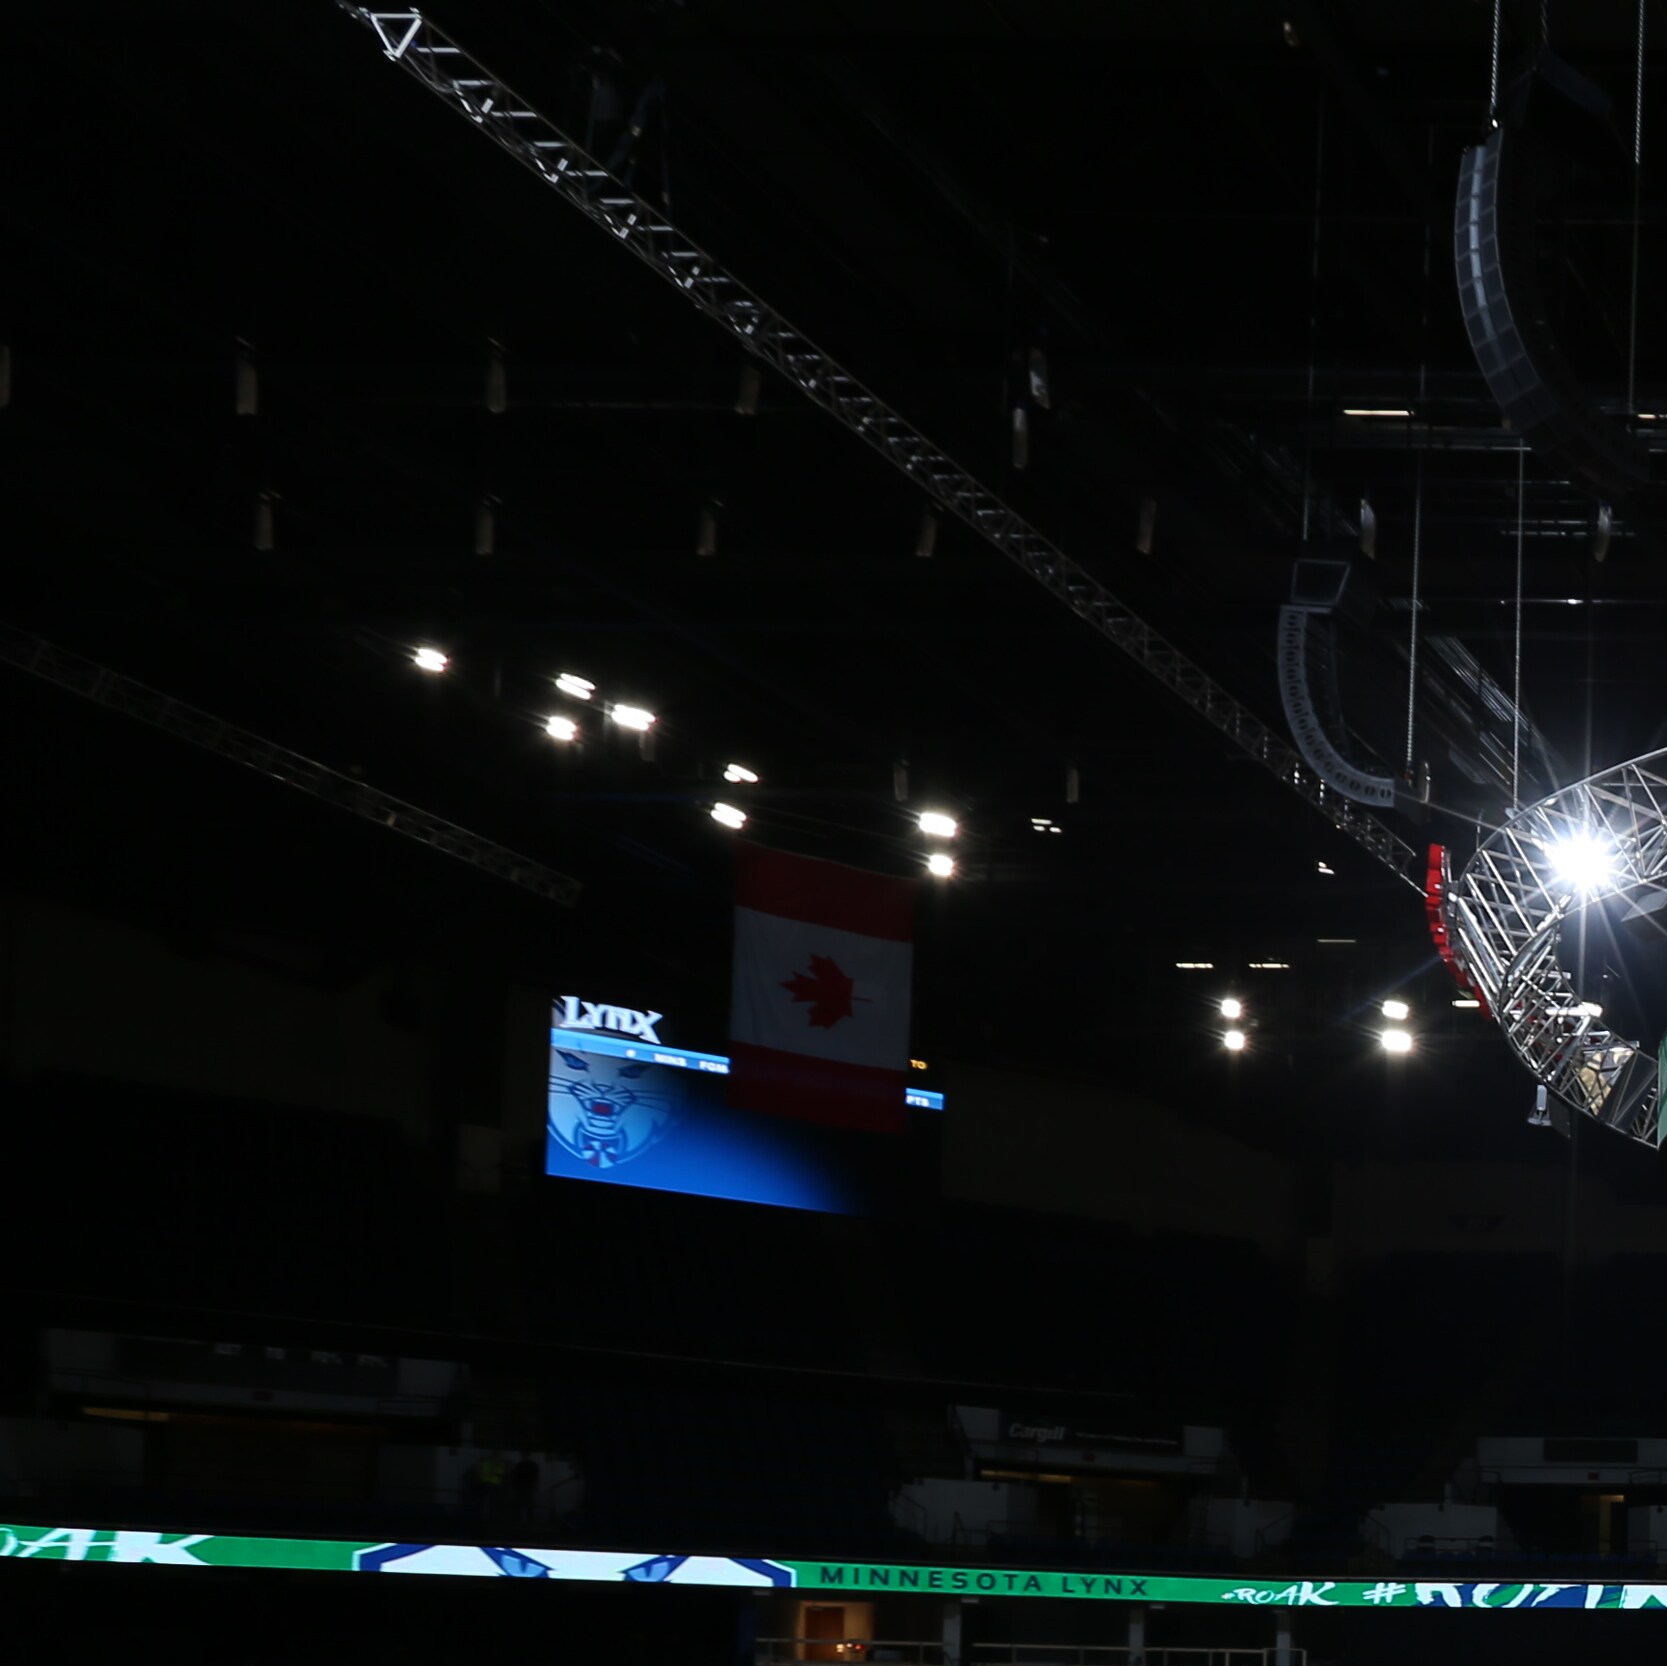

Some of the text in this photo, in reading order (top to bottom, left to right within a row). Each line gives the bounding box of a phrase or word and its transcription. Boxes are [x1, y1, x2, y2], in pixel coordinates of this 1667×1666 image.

[560, 995, 664, 1045] LYNX
[1008, 1422, 1065, 1443] Cargill
[820, 1566, 1043, 1593] MINNESOTA
[1061, 1576, 1150, 1596] LYNX
